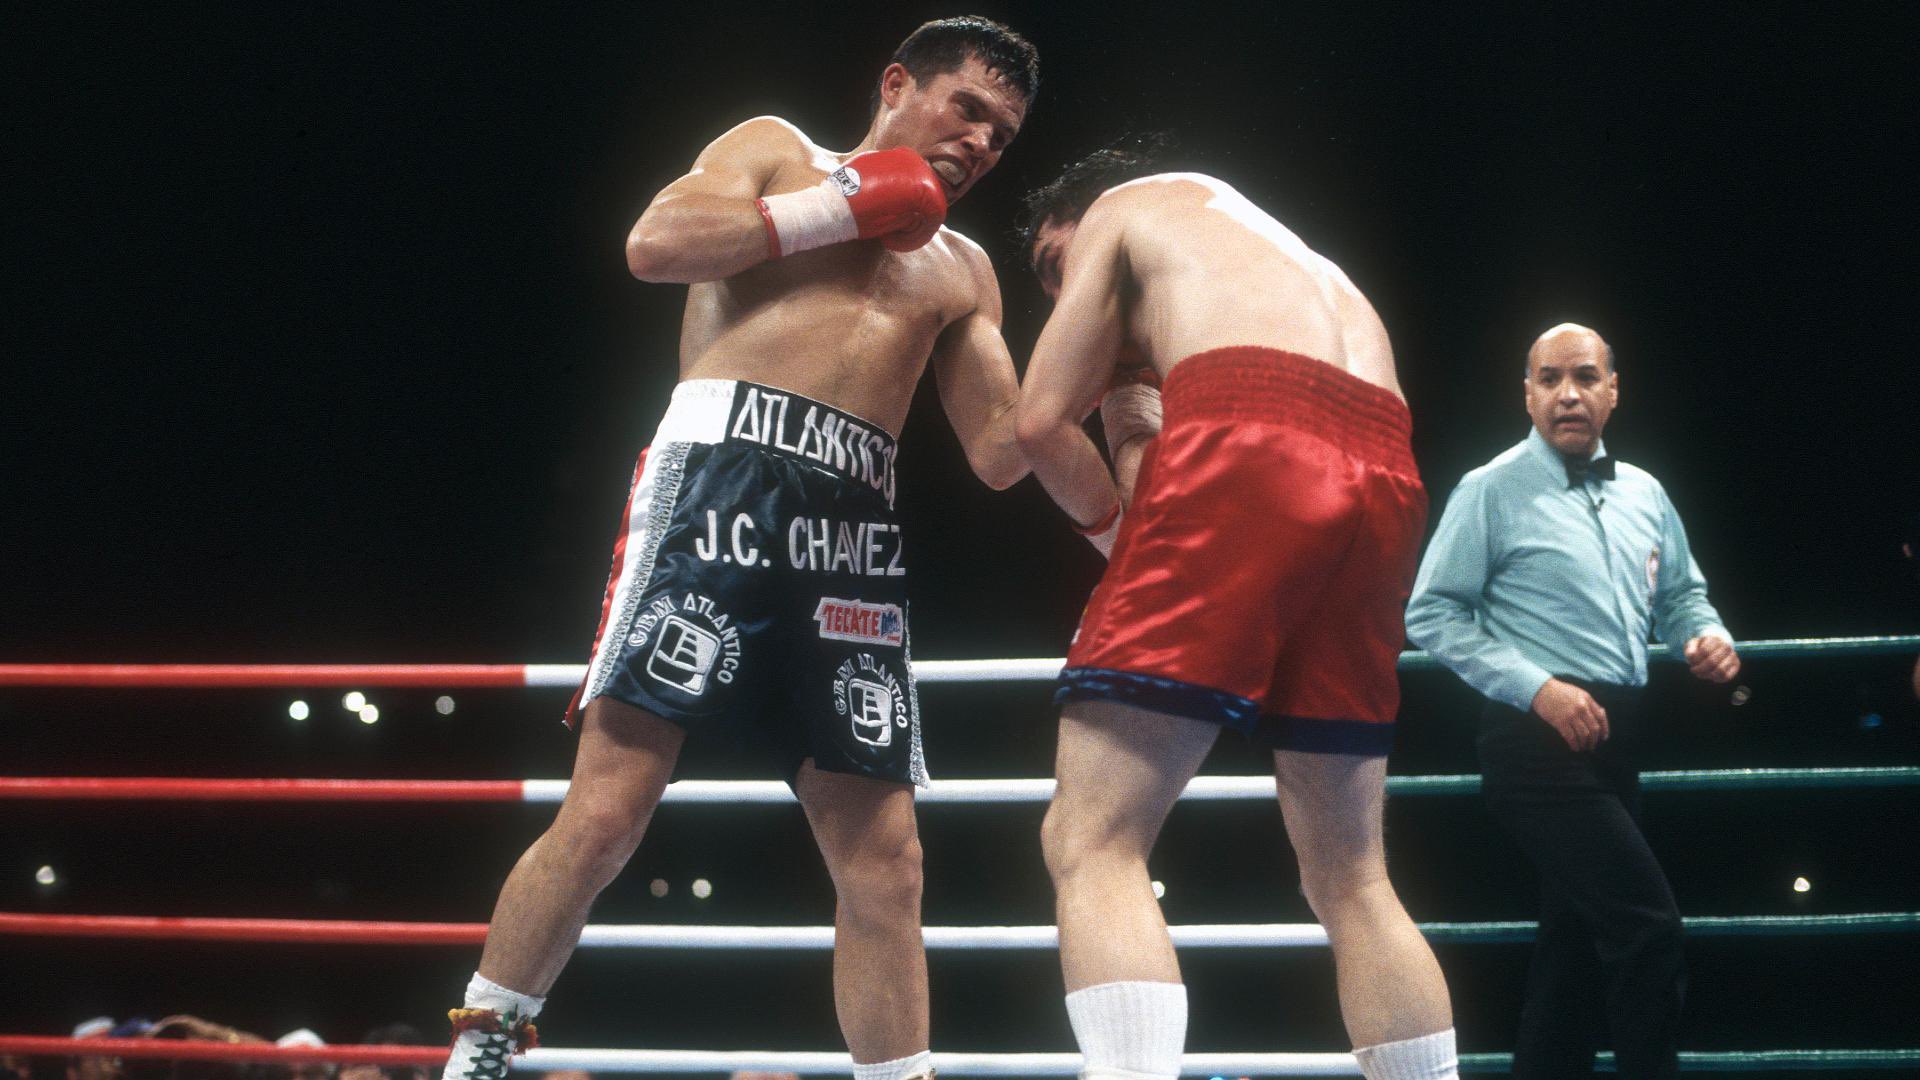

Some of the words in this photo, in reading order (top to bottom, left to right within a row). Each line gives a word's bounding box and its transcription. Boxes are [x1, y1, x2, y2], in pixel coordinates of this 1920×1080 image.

[731, 387, 898, 509] ATLANTICO
[695, 510, 771, 567] J.C.
[789, 516, 906, 576] CHAVEZ
[627, 595, 677, 647] GBM
[683, 592, 741, 684] ATLANTICO
[822, 605, 881, 637] TECATE
[857, 652, 908, 729] ATLANTICO
